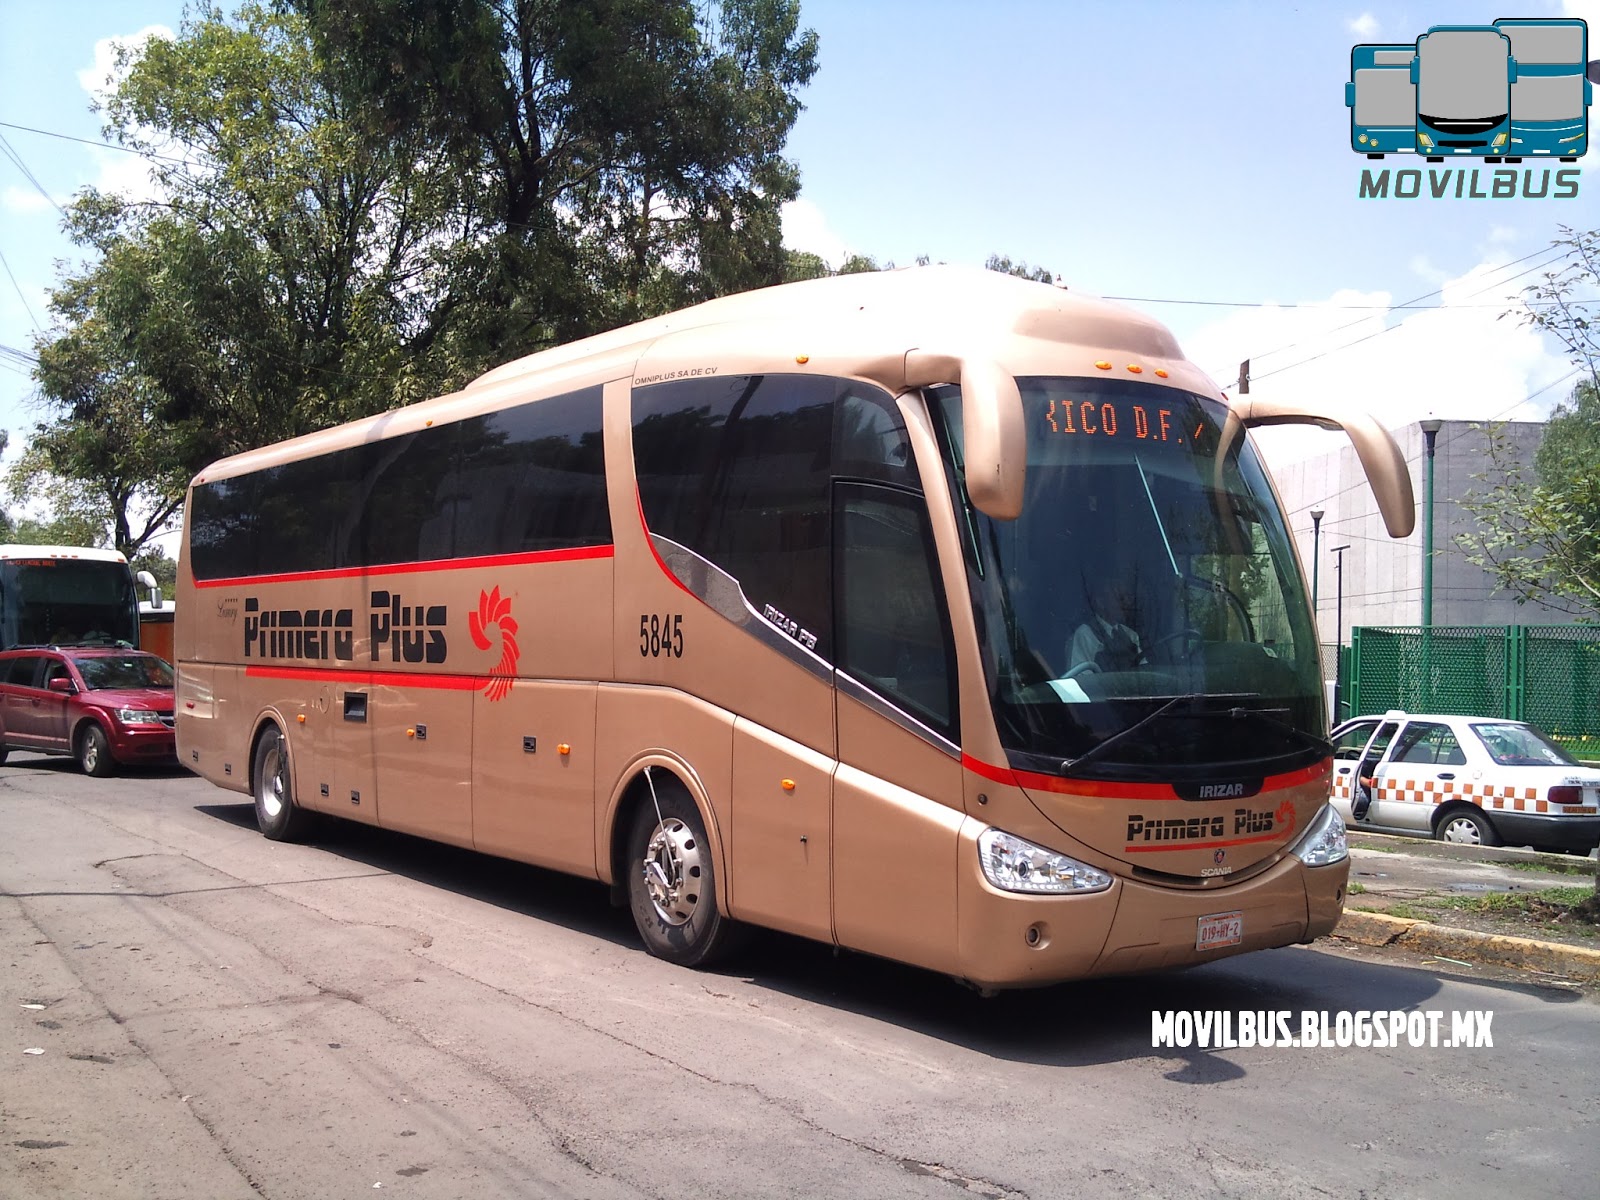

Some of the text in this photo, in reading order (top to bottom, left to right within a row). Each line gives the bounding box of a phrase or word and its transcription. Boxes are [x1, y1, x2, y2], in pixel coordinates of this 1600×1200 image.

[634, 367, 718, 385] OMNIPLUS SA DE CV
[244, 590, 448, 664] Primera Plus
[639, 613, 684, 658] 5845
[763, 603, 818, 650] IRIZAR PB
[1199, 783, 1244, 798] IRIZAR
[1127, 808, 1274, 842] Primera Plus
[1200, 866, 1232, 878] SCANIA
